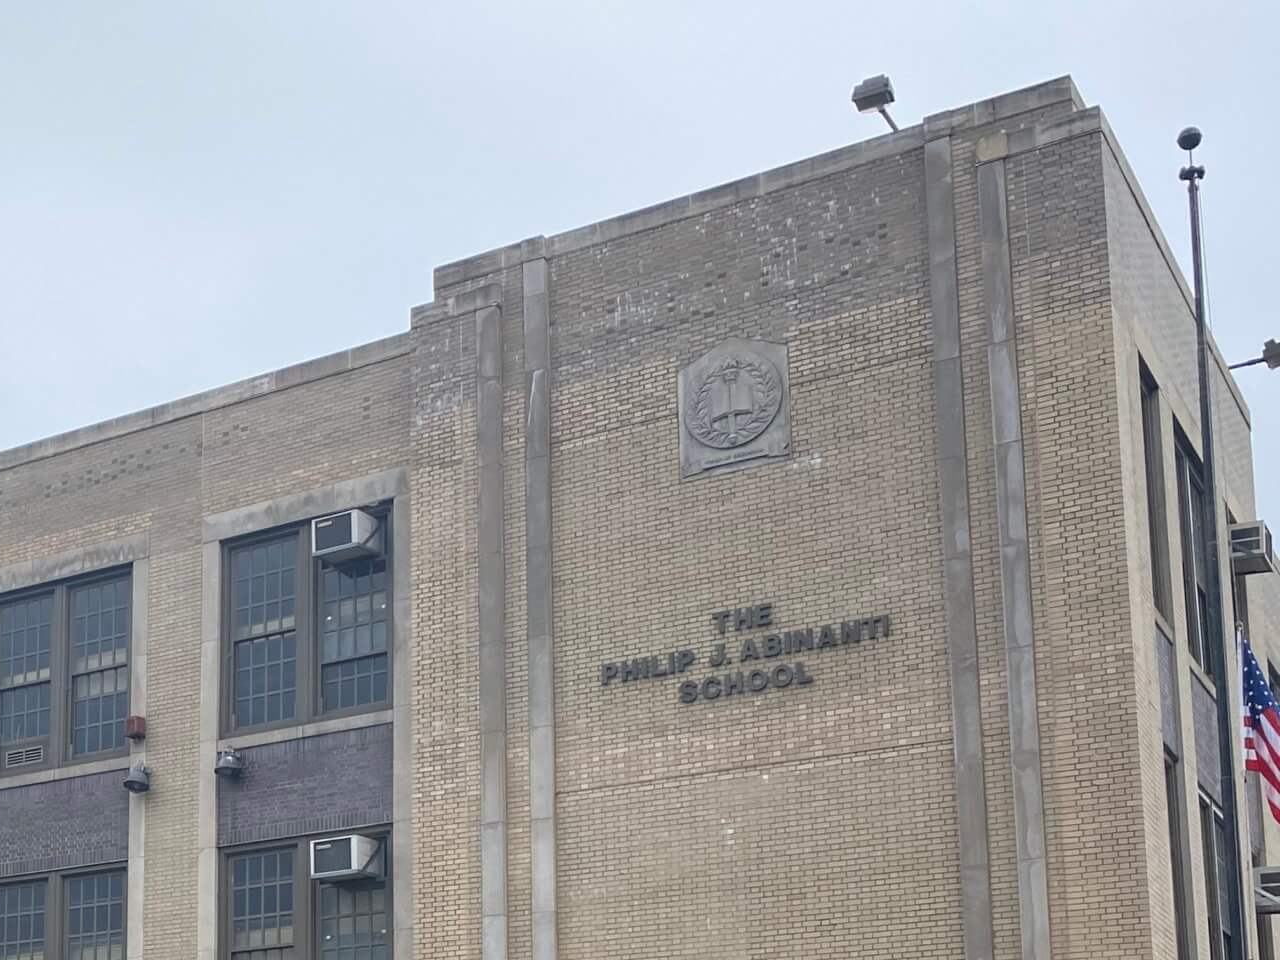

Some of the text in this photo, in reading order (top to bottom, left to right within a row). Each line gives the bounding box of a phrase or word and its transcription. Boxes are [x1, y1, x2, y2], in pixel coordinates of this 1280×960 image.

[712, 603, 772, 635] THE
[601, 614, 891, 686] PHILIP J. ABINANTI
[678, 661, 815, 704] SCHOOL
